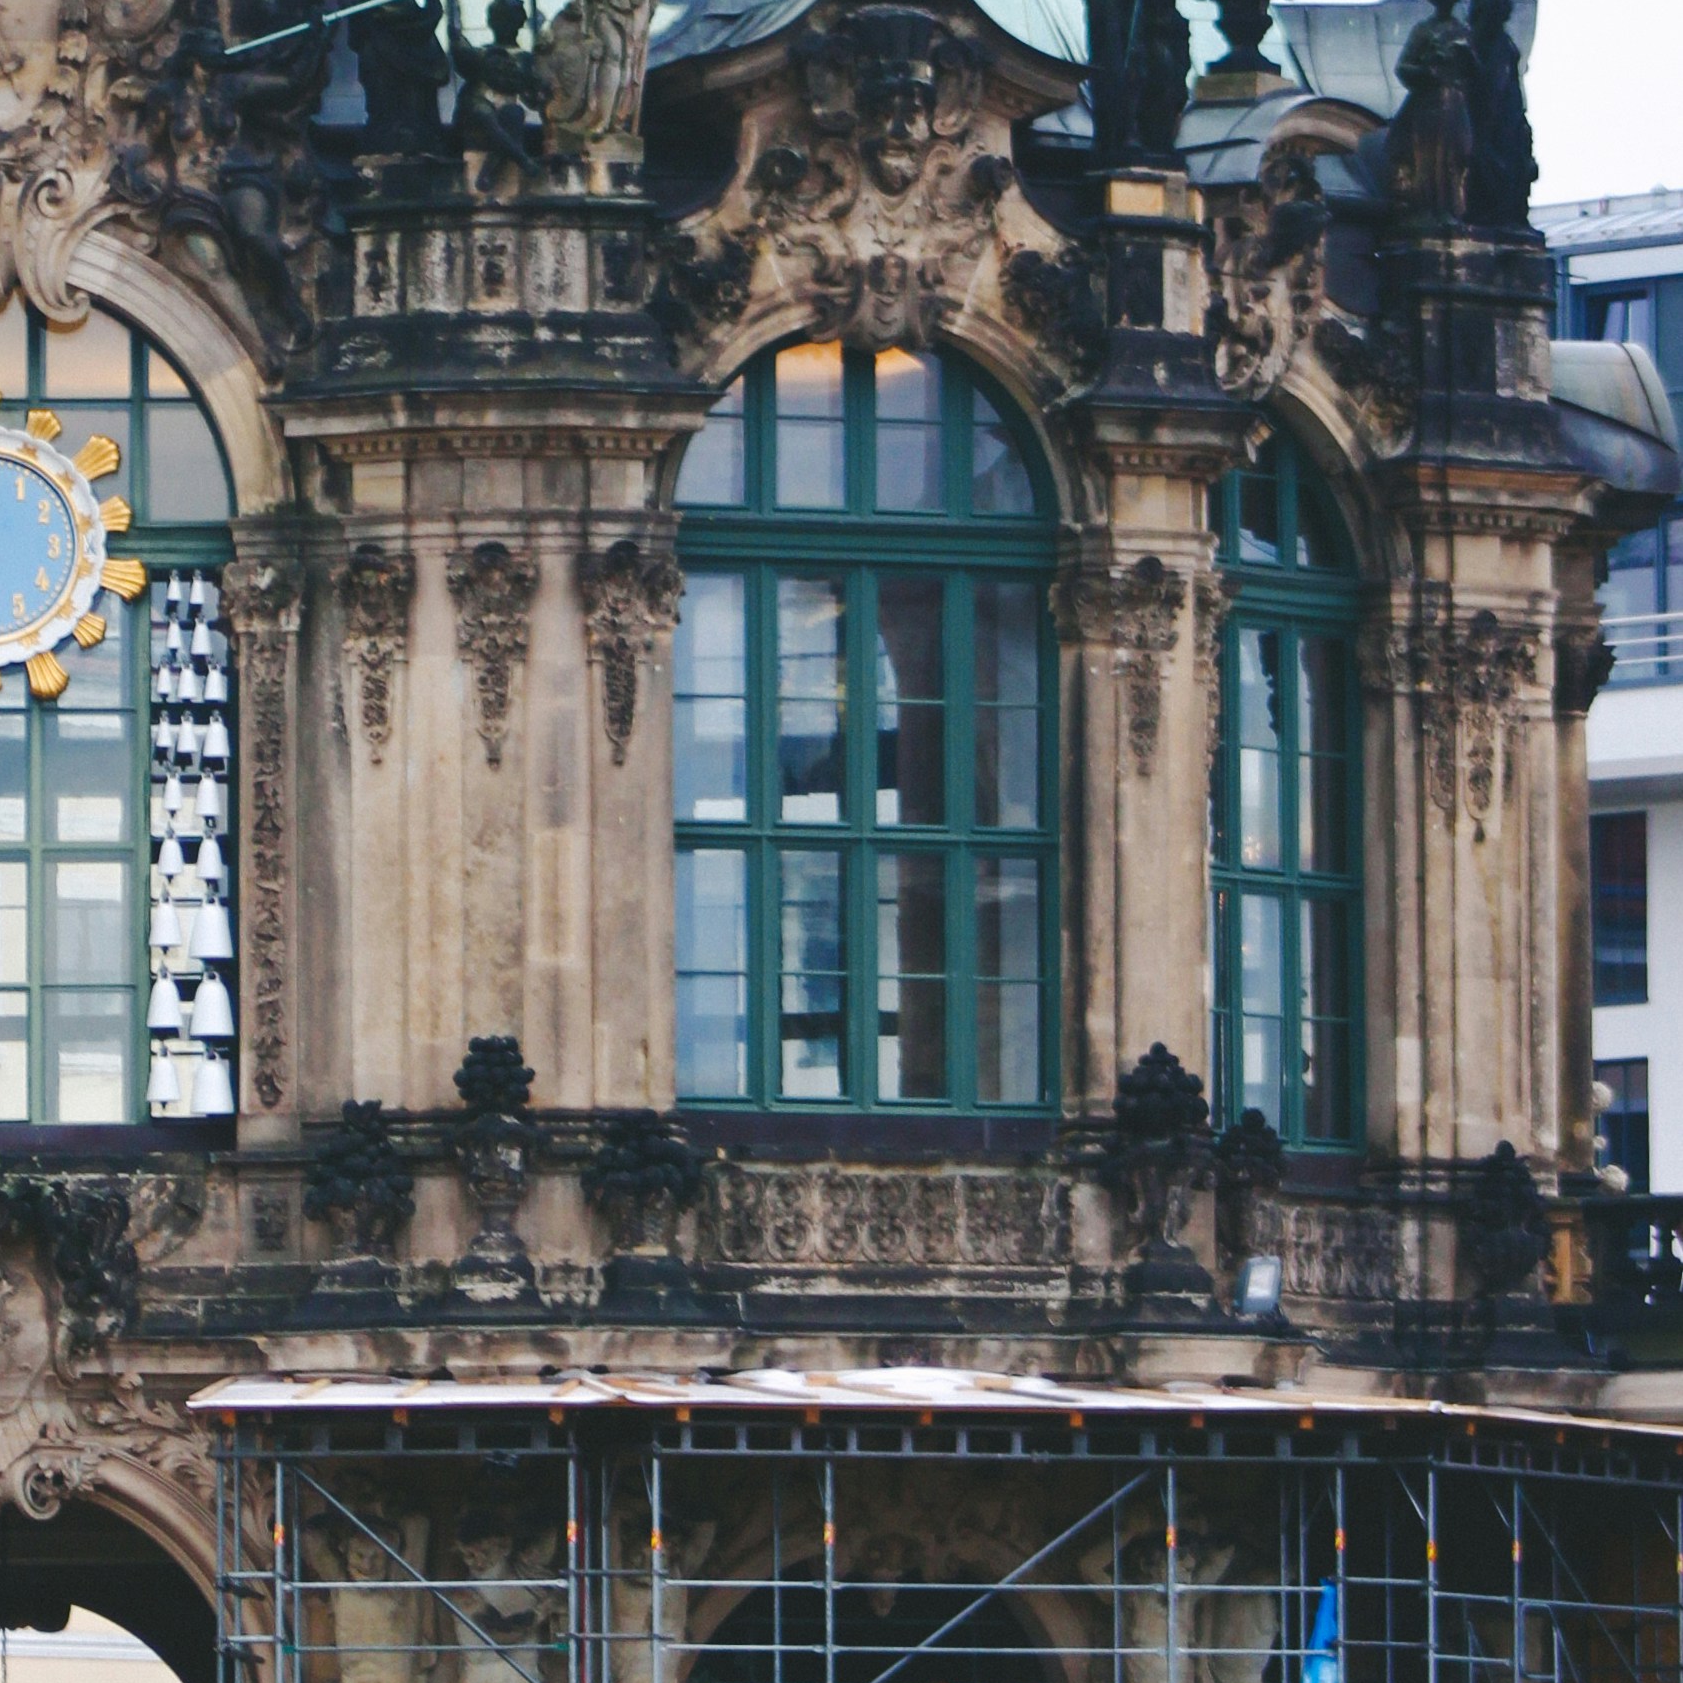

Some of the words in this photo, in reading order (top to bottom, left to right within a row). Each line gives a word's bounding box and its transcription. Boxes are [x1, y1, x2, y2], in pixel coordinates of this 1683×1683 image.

[15, 477, 25, 501] 1
[38, 499, 50, 524] 2
[47, 534, 61, 559] 3
[35, 566, 50, 592] 4
[12, 593, 25, 618] 5
